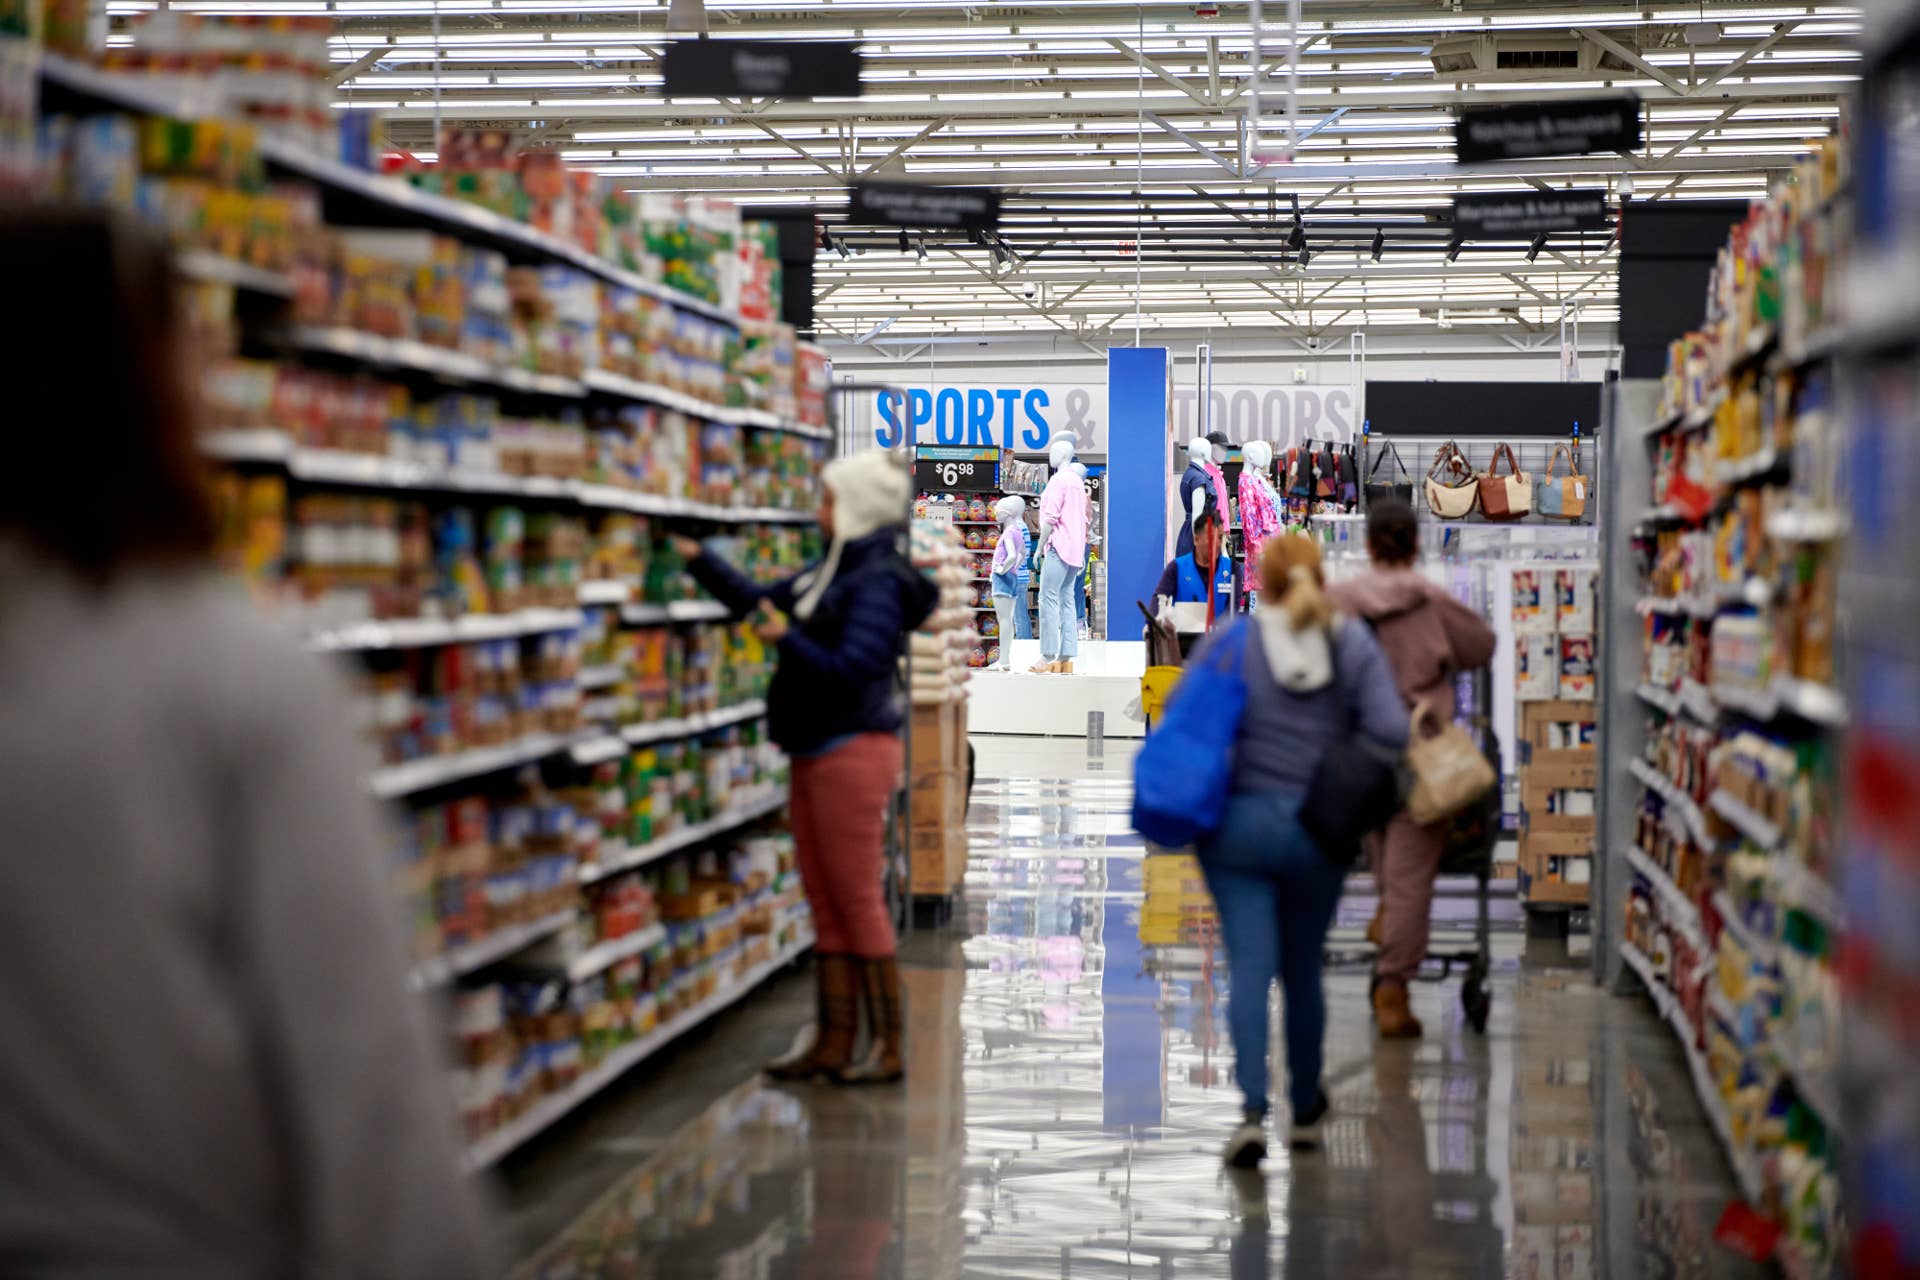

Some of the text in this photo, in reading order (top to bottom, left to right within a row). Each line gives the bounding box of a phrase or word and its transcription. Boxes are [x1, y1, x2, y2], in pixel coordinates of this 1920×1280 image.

[875, 388, 1350, 452] SPORTS & TDOORS
